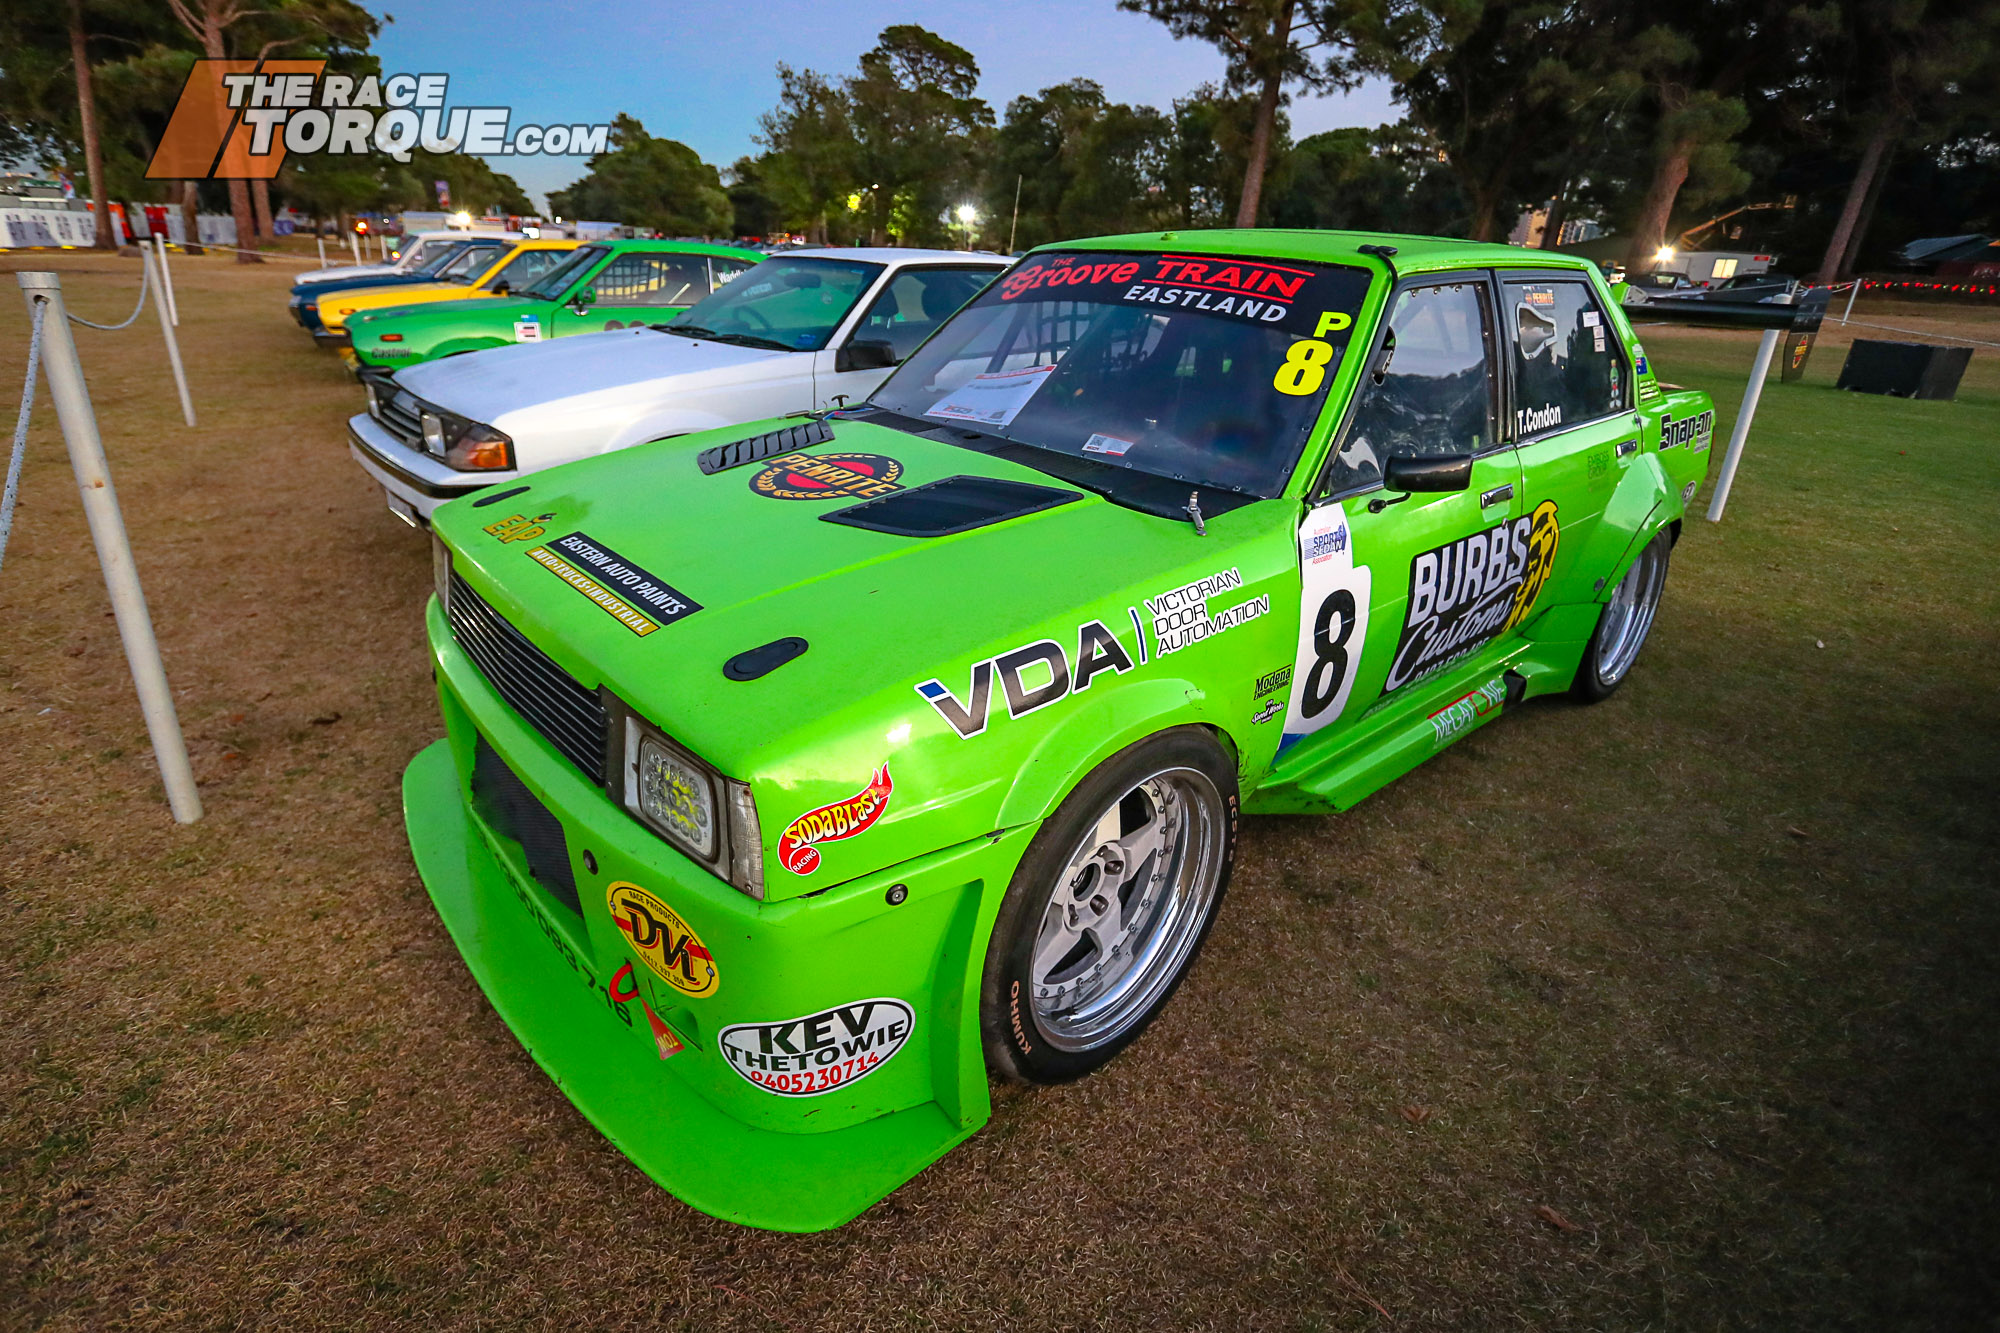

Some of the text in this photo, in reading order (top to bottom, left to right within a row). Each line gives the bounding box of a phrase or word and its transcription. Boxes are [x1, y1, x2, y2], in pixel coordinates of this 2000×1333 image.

[1051, 257, 1075, 268] THE
[1156, 259, 1306, 298] TRAIN
[1123, 284, 1287, 322] EASTLAND
[1312, 311, 1352, 338] P
[1273, 339, 1333, 396] 8
[1517, 403, 1562, 435] T.Condon
[1658, 410, 1713, 452] Snap-on
[769, 453, 899, 498] PENRITE
[482, 513, 546, 545] EAP
[1312, 541, 1343, 558] SEDAN
[1313, 528, 1344, 547] SPORTS
[558, 535, 688, 616] EASTERN AUTO PAINTS
[1145, 567, 1242, 617] VICTORIAN
[1153, 602, 1207, 637] DOOR
[1156, 596, 1270, 657] AUTOMATION
[1385, 575, 1524, 692] Customs
[1300, 588, 1357, 720] 8
[915, 620, 1134, 739] VDA
[1255, 666, 1291, 693] Modena
[1429, 679, 1505, 742] MEGATONE
[792, 849, 818, 872] RACING
[628, 890, 681, 930] RACE PRODUCTS
[757, 1003, 875, 1055] KEV
[1009, 979, 1032, 1056] KUMHO
[656, 1031, 679, 1053] TOW
[750, 1051, 879, 1094] 0405230714
